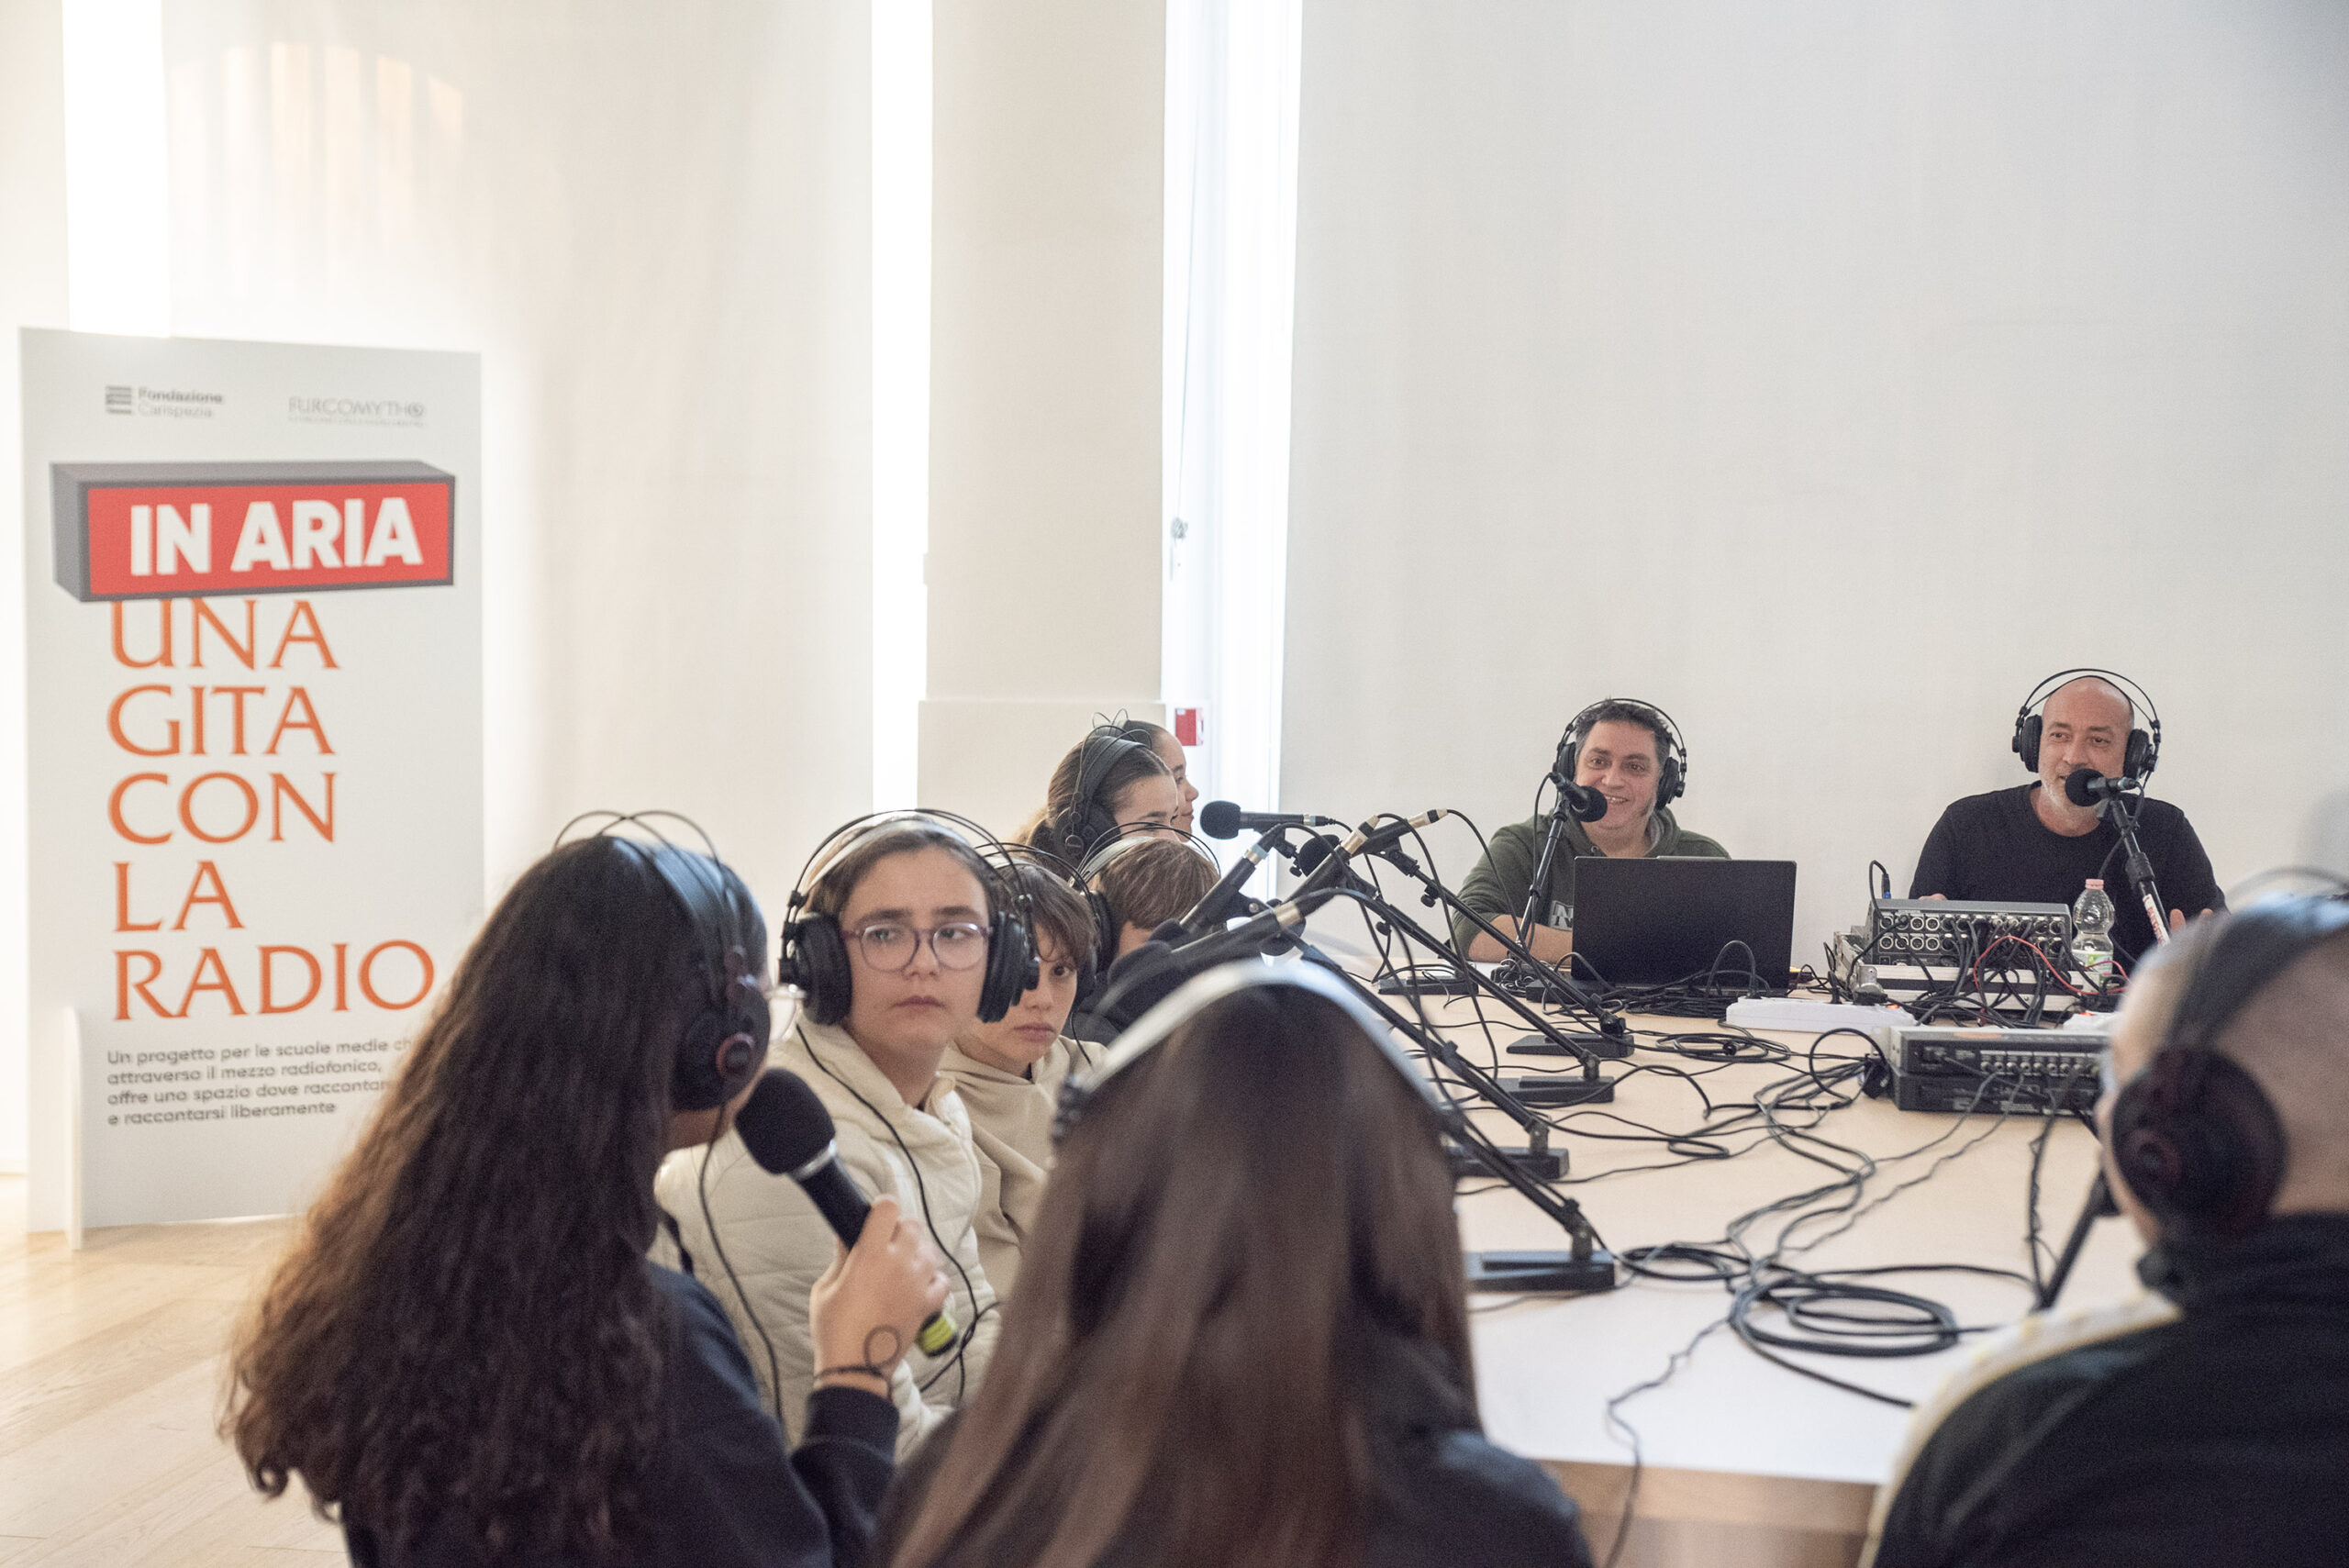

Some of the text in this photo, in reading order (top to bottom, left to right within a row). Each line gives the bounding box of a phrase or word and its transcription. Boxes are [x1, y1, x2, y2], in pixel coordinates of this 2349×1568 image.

[139, 386, 224, 404] Fondazione
[130, 497, 424, 576] IN ARIA
[110, 598, 340, 672] UNA
[106, 684, 336, 757] GITA
[107, 771, 338, 845] CON
[114, 860, 246, 932] LA
[114, 939, 436, 1020] RADIO
[107, 1037, 412, 1066] Un progetto per le scuole medie ch
[107, 1059, 382, 1085] attraverso il mezzo radiofonico,
[107, 1089, 149, 1105] offre
[194, 1084, 250, 1102] spazio
[256, 1084, 298, 1098] dove
[304, 1079, 392, 1095] raccontar
[107, 1101, 336, 1126] e raccontarsi liberamente
